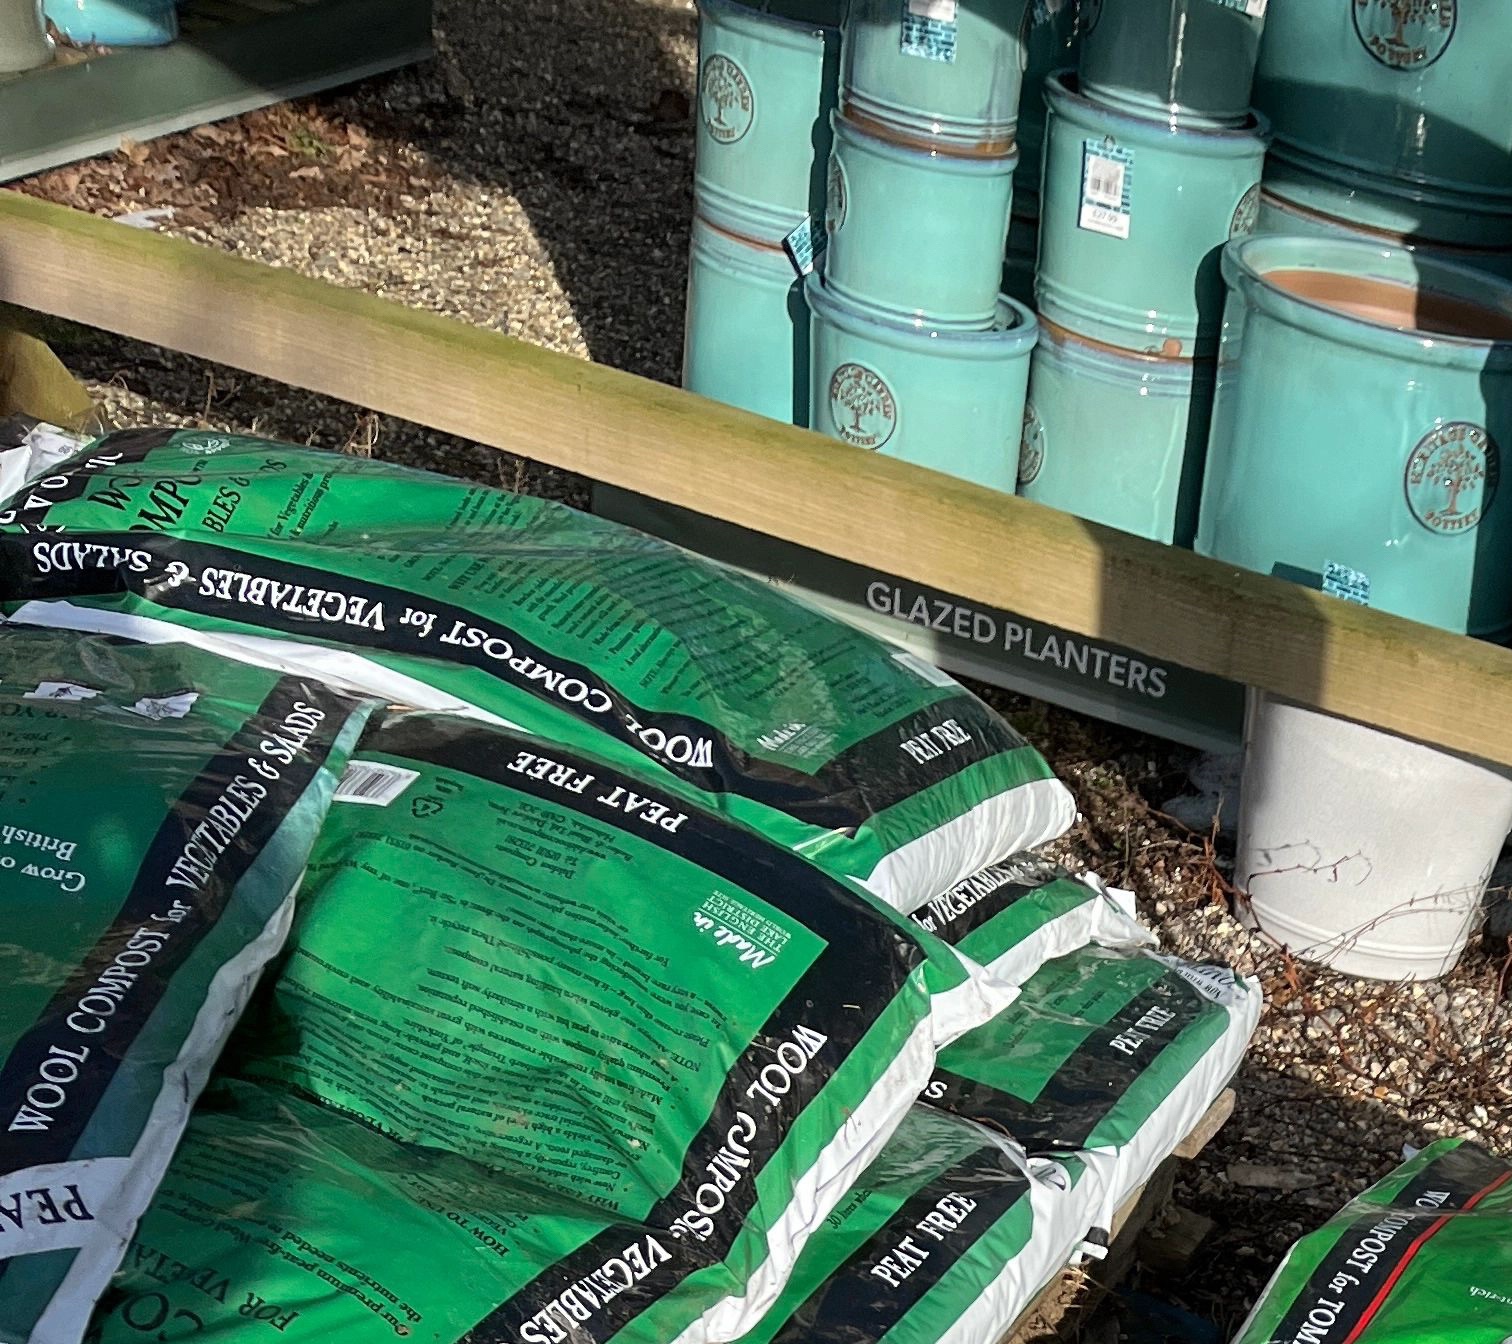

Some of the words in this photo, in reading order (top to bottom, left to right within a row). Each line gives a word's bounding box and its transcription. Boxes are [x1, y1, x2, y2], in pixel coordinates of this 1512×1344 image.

[33, 541, 152, 573] SALADS
[200, 566, 385, 631] VEGETABLES
[400, 607, 437, 638] for
[866, 581, 997, 645] GLAZED
[1004, 621, 1168, 698] PLANTERS
[440, 620, 612, 713] COMPOST
[261, 701, 327, 766] SALADS
[624, 713, 713, 768] WOOL
[247, 756, 281, 782] &
[507, 751, 595, 793] FREE
[598, 785, 688, 833] PEAT
[2, 824, 78, 861] British
[165, 775, 267, 892] VEGETABLES
[20, 861, 87, 893] Grow
[150, 898, 193, 925] for
[713, 927, 776, 968] Made
[66, 927, 169, 1034] COMPOST
[8, 1044, 91, 1135] WOOL
[746, 1024, 828, 1107] WOOL
[870, 1236, 931, 1287] PEAT
[925, 1188, 977, 1243] FREE
[1328, 1271, 1360, 1294] for
[238, 1292, 299, 1332] FOR
